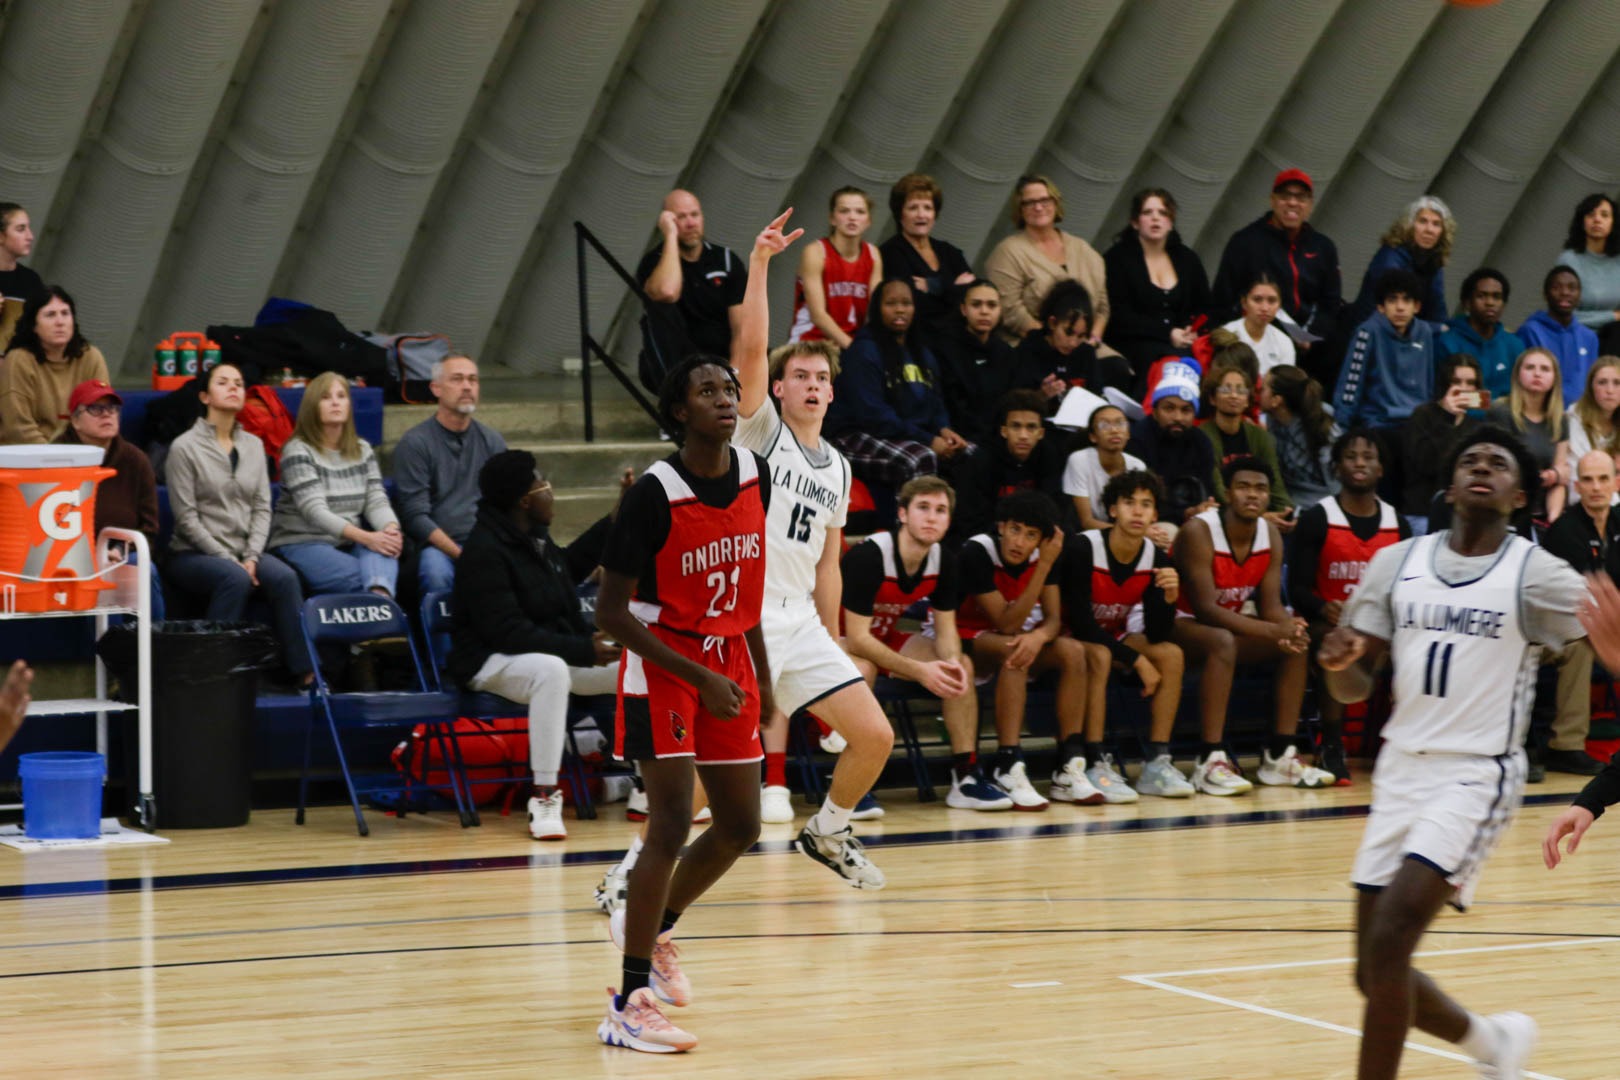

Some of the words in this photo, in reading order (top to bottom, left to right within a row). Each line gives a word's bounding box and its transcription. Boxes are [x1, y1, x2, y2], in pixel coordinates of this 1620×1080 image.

[772, 465, 791, 490] LA
[38, 489, 83, 541] G
[786, 501, 817, 543] 15
[681, 532, 760, 577] ANDREWS
[318, 604, 394, 624] LAKERS
[1423, 640, 1455, 698] 11
